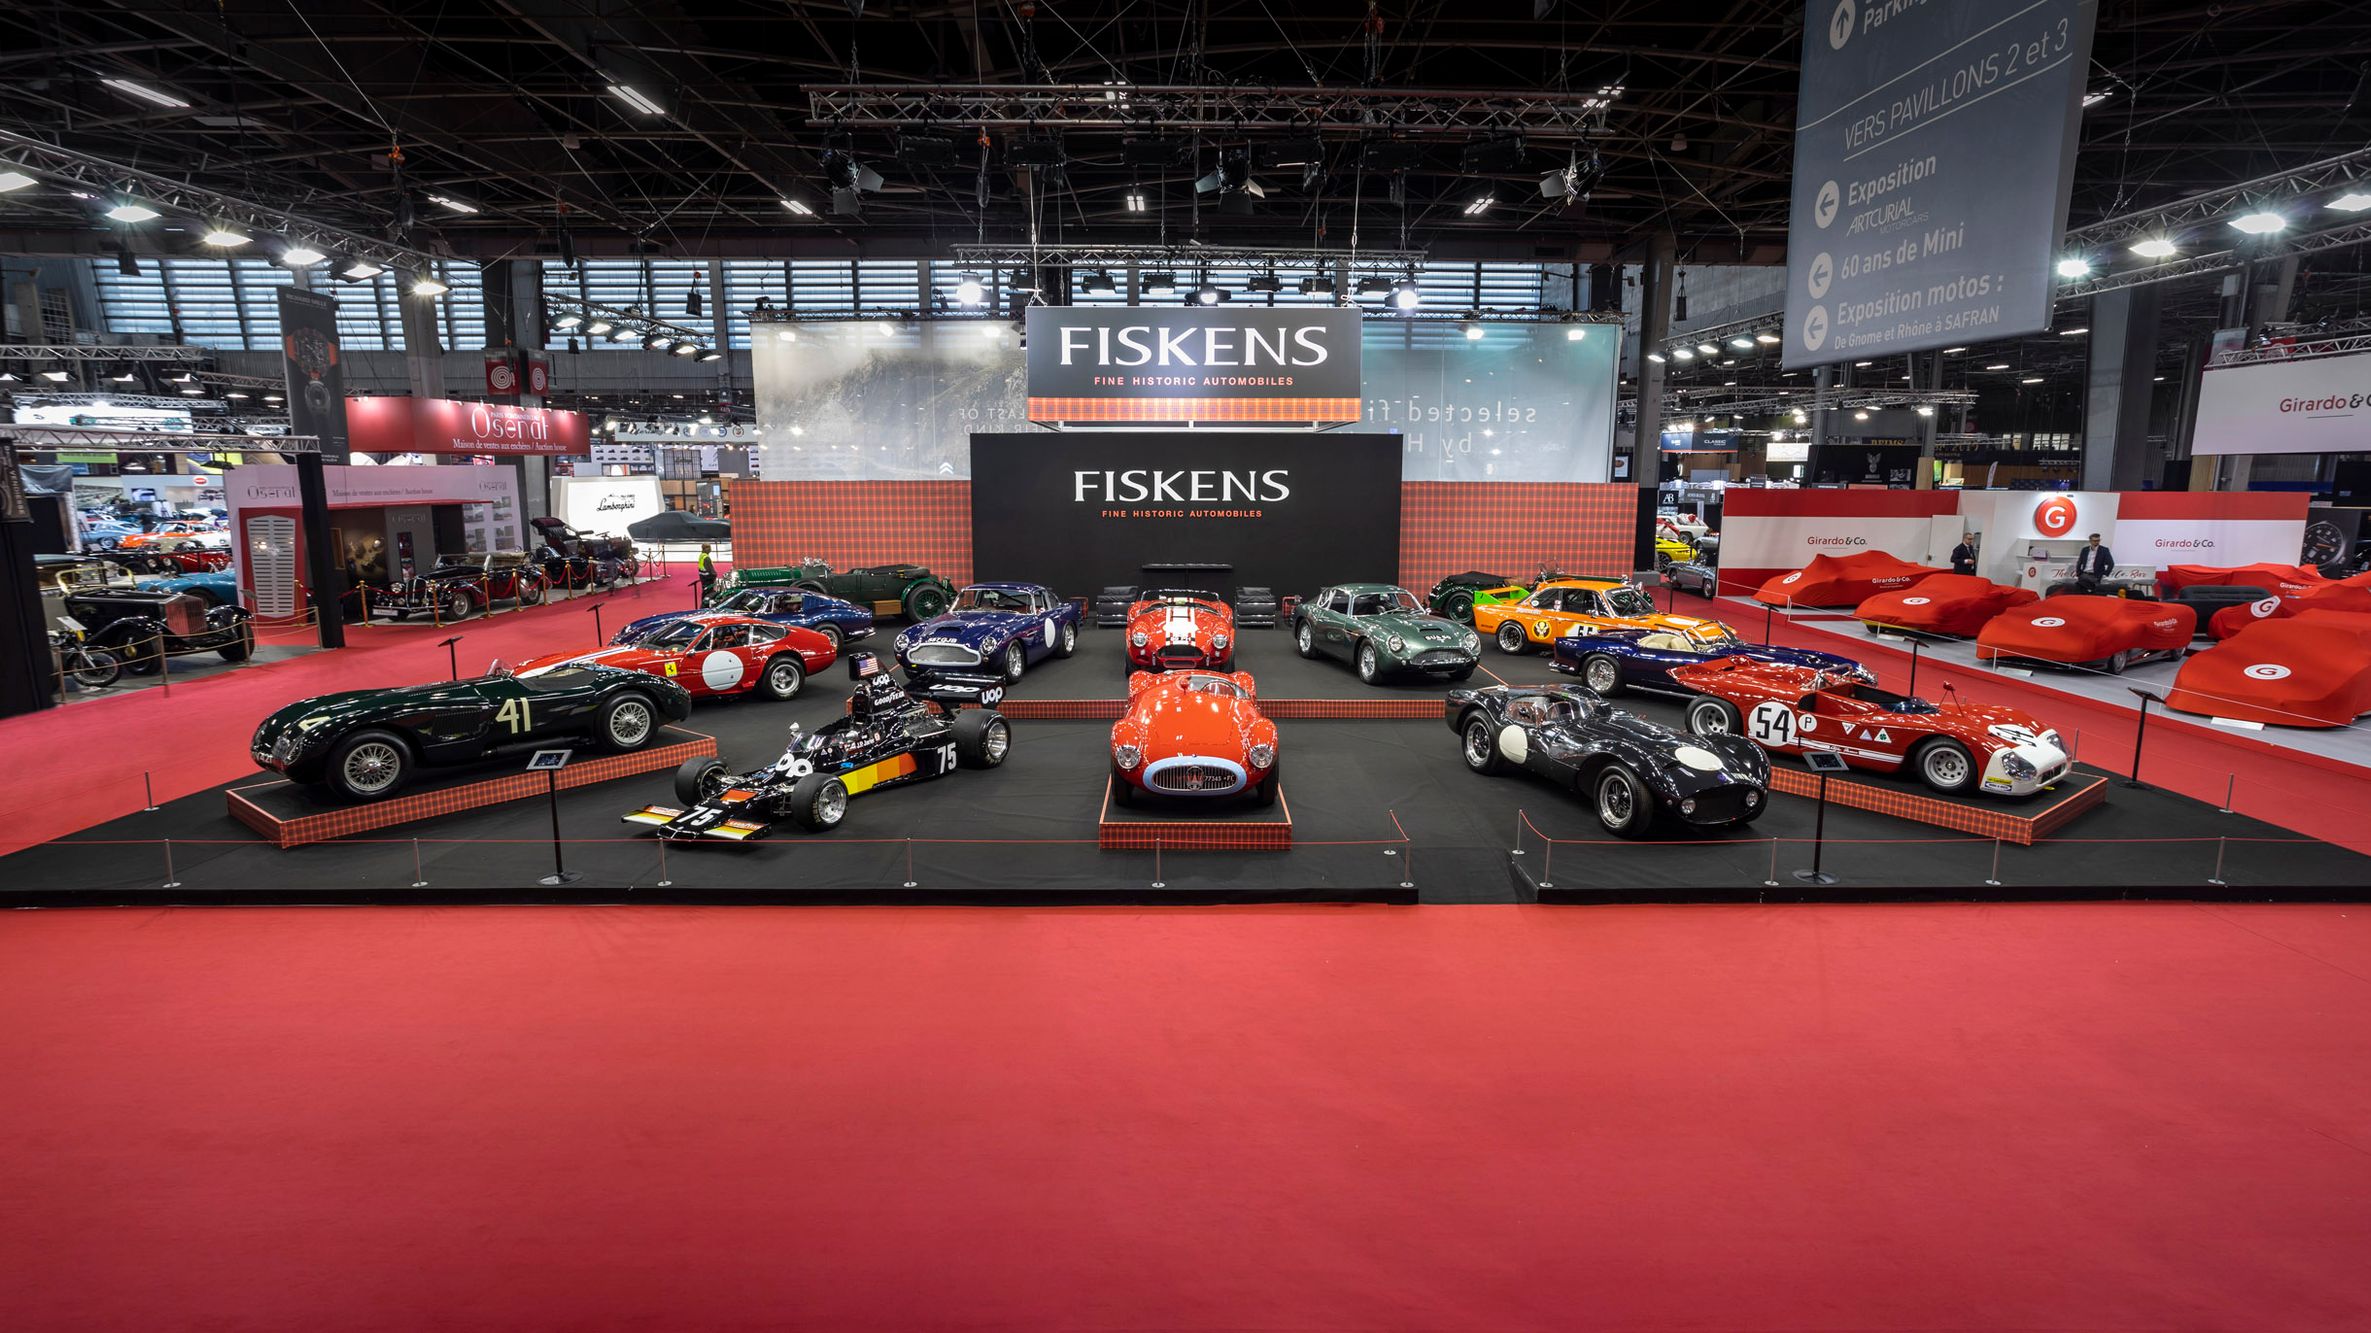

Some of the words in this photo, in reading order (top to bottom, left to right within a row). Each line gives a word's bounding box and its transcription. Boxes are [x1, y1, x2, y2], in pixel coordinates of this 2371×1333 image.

[1864, 0, 1927, 34] Park
[1844, 109, 1886, 150] VERS
[1890, 53, 1999, 129] PAVILLONS
[2005, 43, 2020, 76] 2
[2025, 31, 2050, 66] et
[2054, 18, 2068, 51] 3
[1848, 155, 1937, 206] Exposition
[1846, 197, 1915, 236] ARTCURIAL
[1880, 212, 1929, 234] MOTORCARS
[1841, 255, 1859, 280] 60
[1863, 252, 1891, 274] ans
[1896, 239, 1917, 265] de
[1923, 221, 1964, 258] Mini
[1837, 290, 1922, 327] Exposition
[1927, 273, 1990, 306] motos
[1834, 336, 1846, 350] De
[1848, 331, 1882, 348] Gnome
[1884, 331, 1895, 344] et
[1897, 320, 1932, 339] Rhône
[1944, 305, 2000, 330] SAFRAN
[1059, 326, 1329, 367] FISKENS
[1094, 376, 1124, 386] FINE
[1132, 376, 1196, 386] HISTORIC
[1203, 376, 1294, 386] AUTOMOBILES
[2279, 395, 2347, 413] Girardo
[2350, 393, 2364, 409] &
[471, 406, 549, 440] Osenat
[453, 438, 475, 449] Maison
[476, 440, 483, 449] de
[1074, 470, 1290, 502] FISKENS
[596, 497, 636, 513] Lamborghini
[1102, 510, 1127, 518] FINE
[1133, 510, 1184, 518] HISTORIC
[1190, 510, 1263, 518] AUTOMOBILES
[2045, 506, 2066, 529] G
[1807, 536, 1844, 545] Girardo
[1845, 536, 1853, 545] &
[1853, 536, 1868, 545] Co.
[2155, 539, 2192, 549] Girardo
[2192, 539, 2201, 549] &
[2201, 539, 2215, 549] Co.
[2259, 600, 2274, 613] G
[2256, 667, 2278, 676] G
[495, 697, 531, 734] 41
[1755, 706, 1790, 742] 54
[1804, 716, 1812, 729] P
[937, 742, 957, 774] 75
[676, 804, 723, 827] 75
